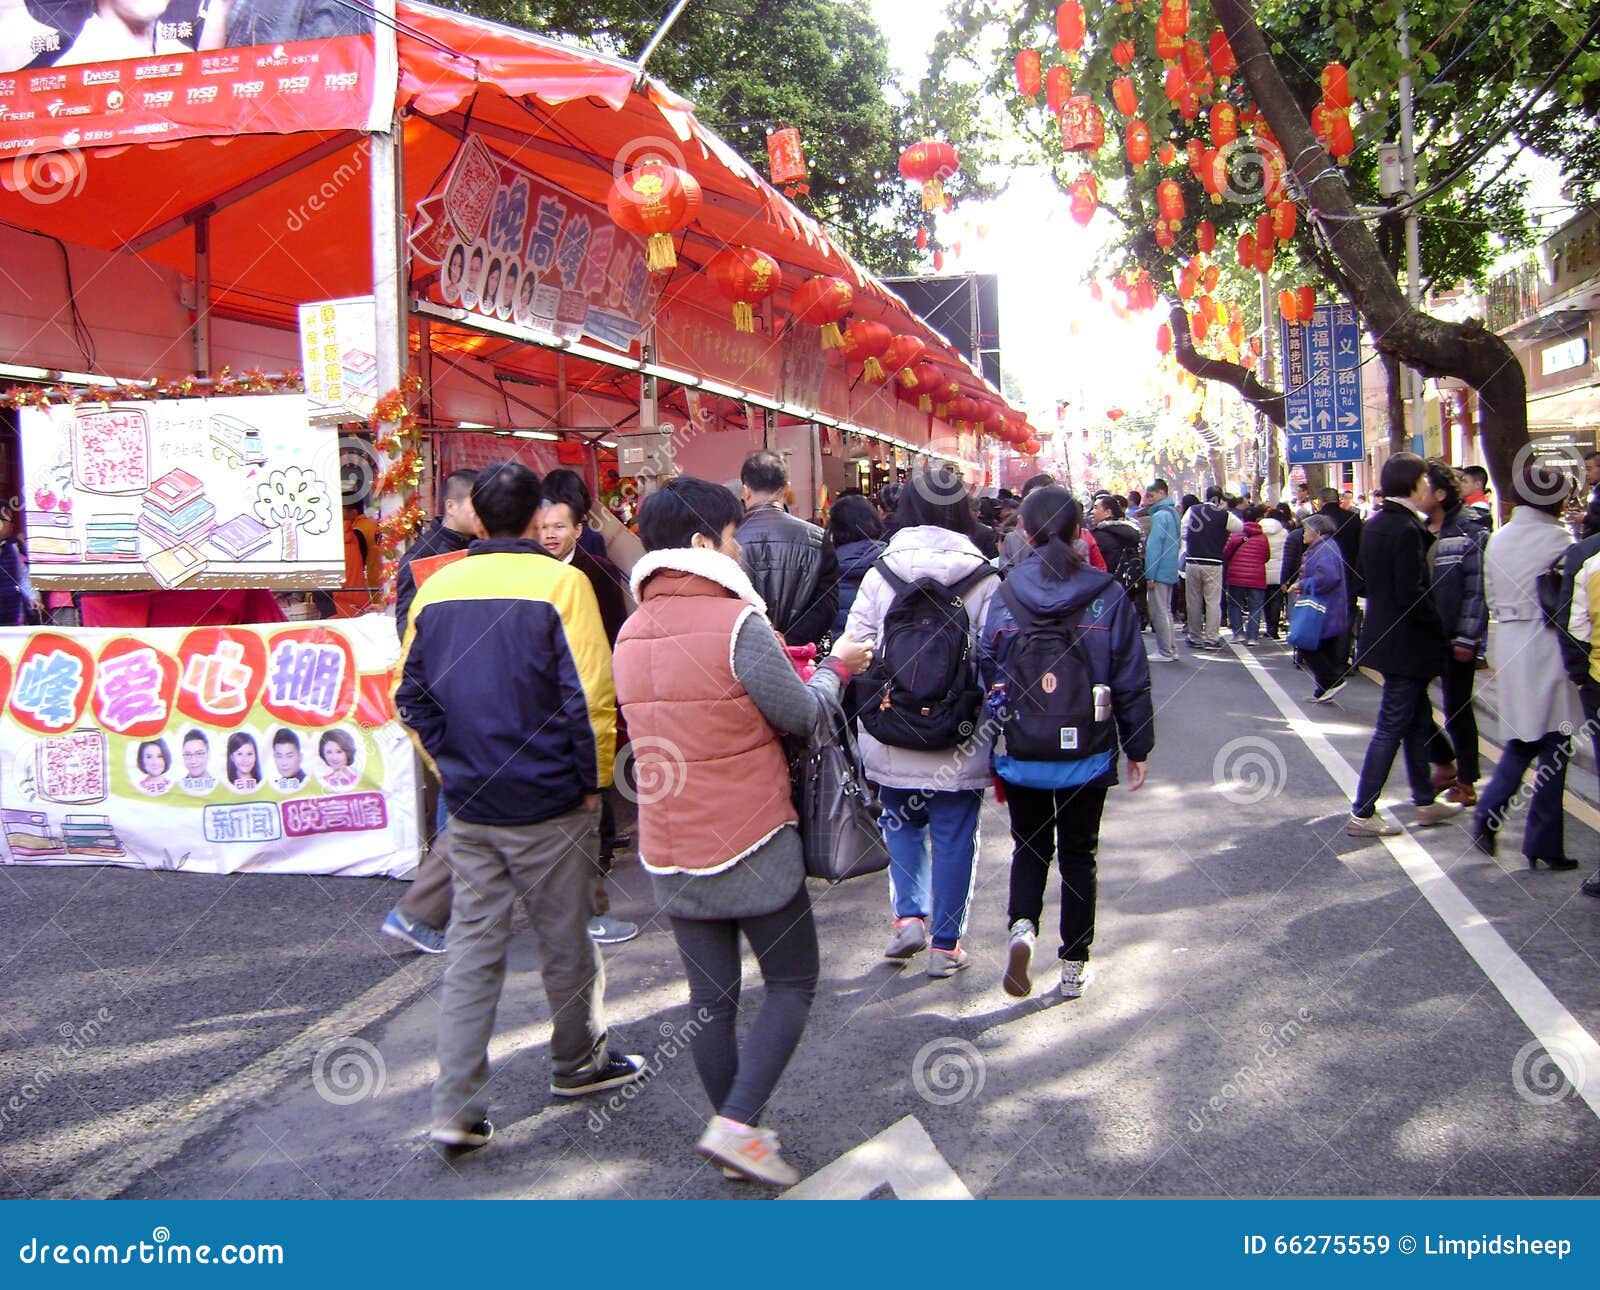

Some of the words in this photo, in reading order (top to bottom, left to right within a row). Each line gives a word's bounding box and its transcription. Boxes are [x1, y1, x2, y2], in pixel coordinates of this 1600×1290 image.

[161, 21, 193, 40] 杨森
[1289, 320, 1305, 387] 京路步行街
[1311, 311, 1331, 387] 惠福东路
[1301, 434, 1349, 450] 西湖路
[17, 640, 345, 731] 峰爱心棚
[211, 806, 274, 840] 新闻
[286, 797, 384, 833] 晚高峰
